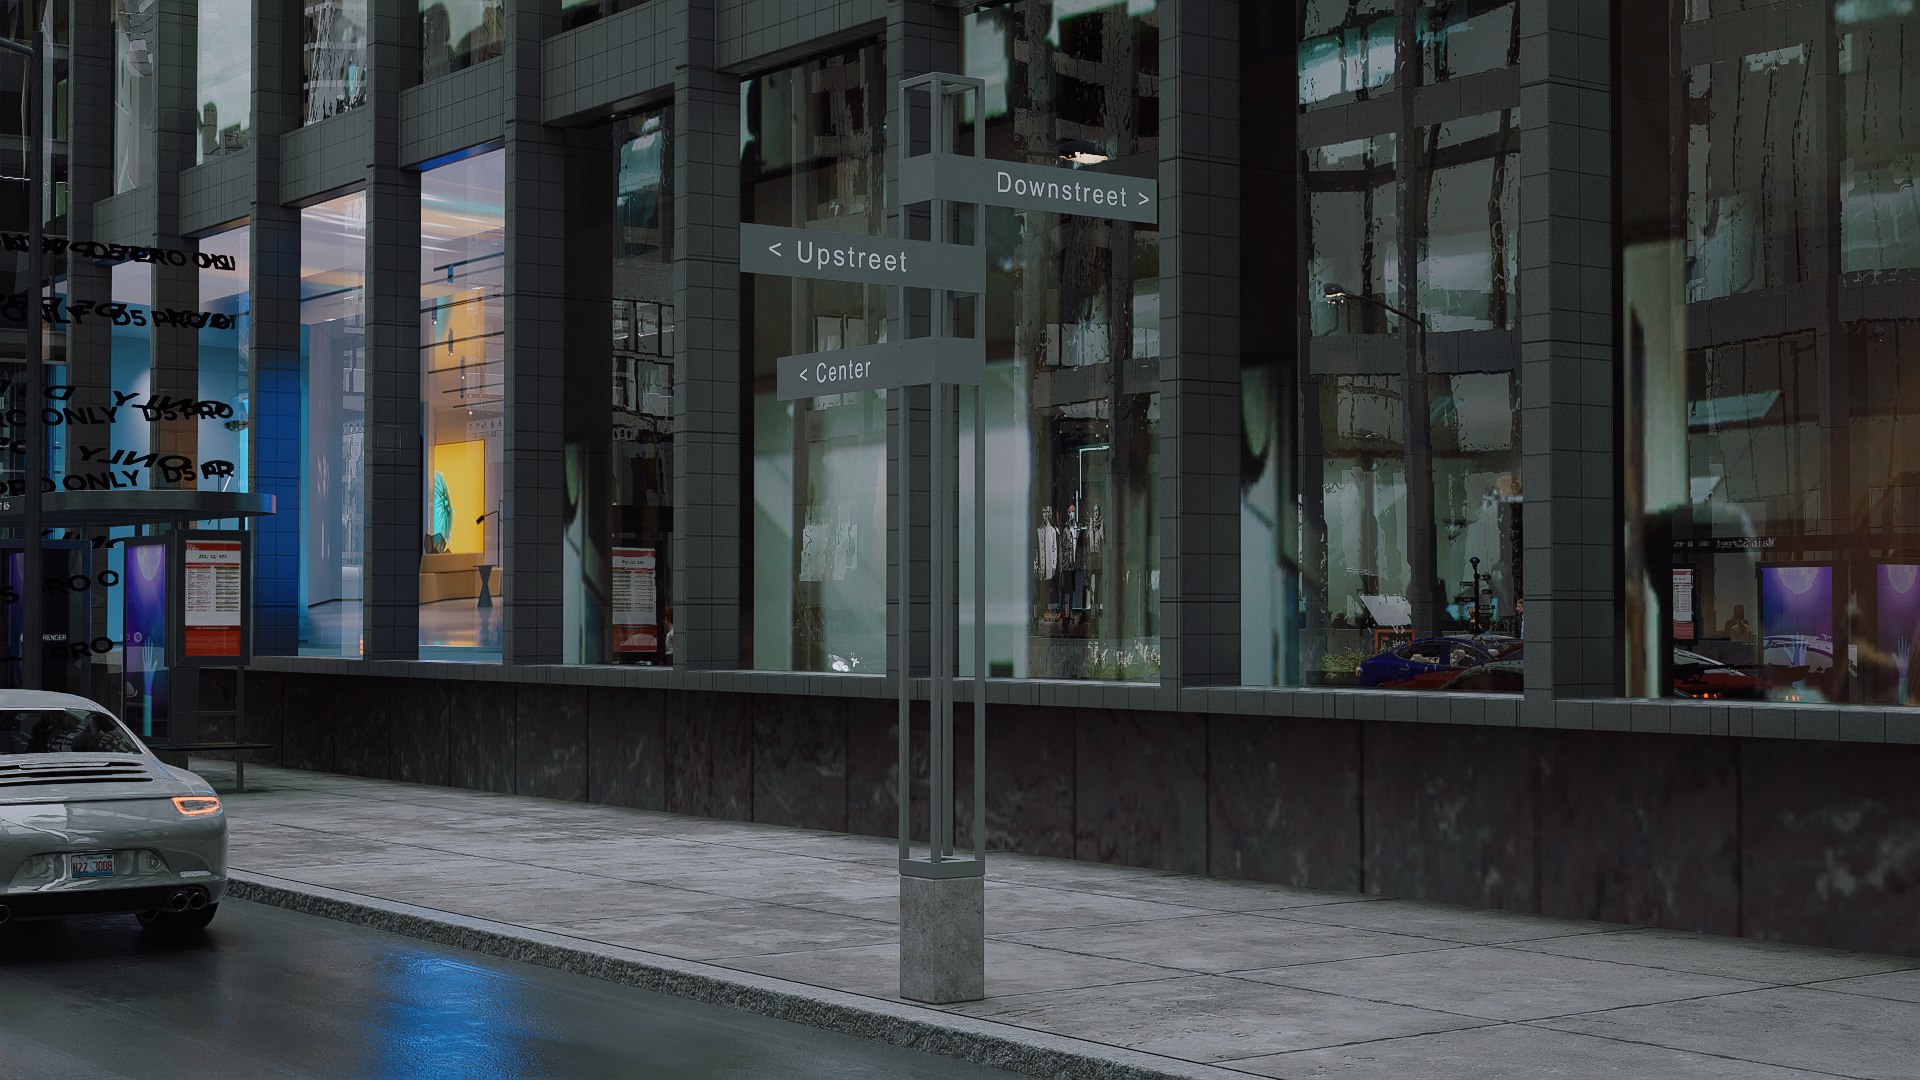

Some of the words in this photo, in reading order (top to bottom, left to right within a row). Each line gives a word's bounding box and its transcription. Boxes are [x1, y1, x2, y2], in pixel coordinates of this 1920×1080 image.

[997, 171, 1127, 207] Downstreet
[797, 240, 907, 272] Upstreet
[816, 359, 871, 383] Center
[42, 406, 118, 426] ONLY
[63, 470, 139, 491] ONLY
